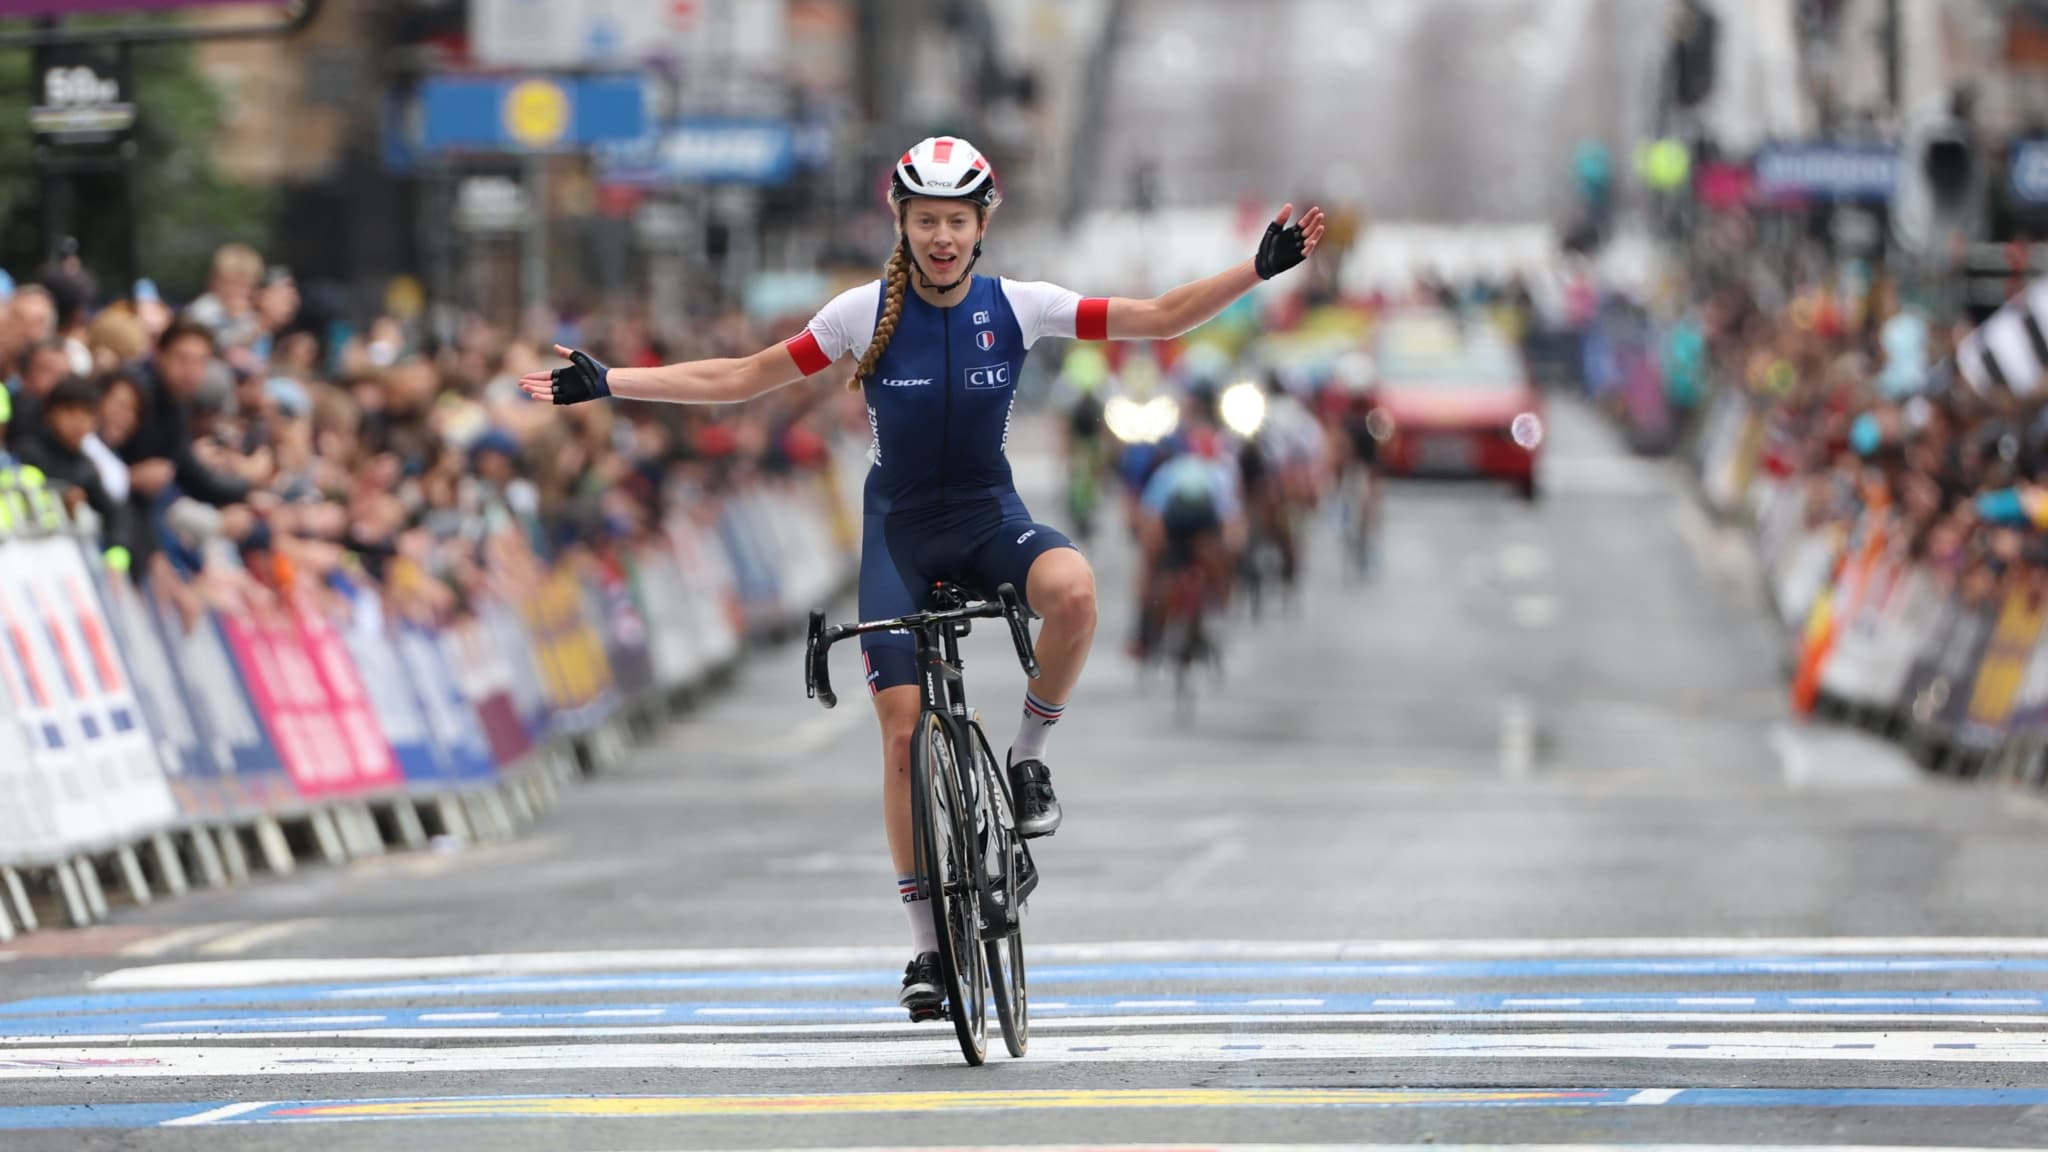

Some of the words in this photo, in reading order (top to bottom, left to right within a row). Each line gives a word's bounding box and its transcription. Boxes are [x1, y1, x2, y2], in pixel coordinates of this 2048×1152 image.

[882, 378, 933, 386] LOOK
[970, 367, 1007, 384] CIC
[867, 403, 882, 467] FRANCE
[926, 671, 935, 705] LOOK
